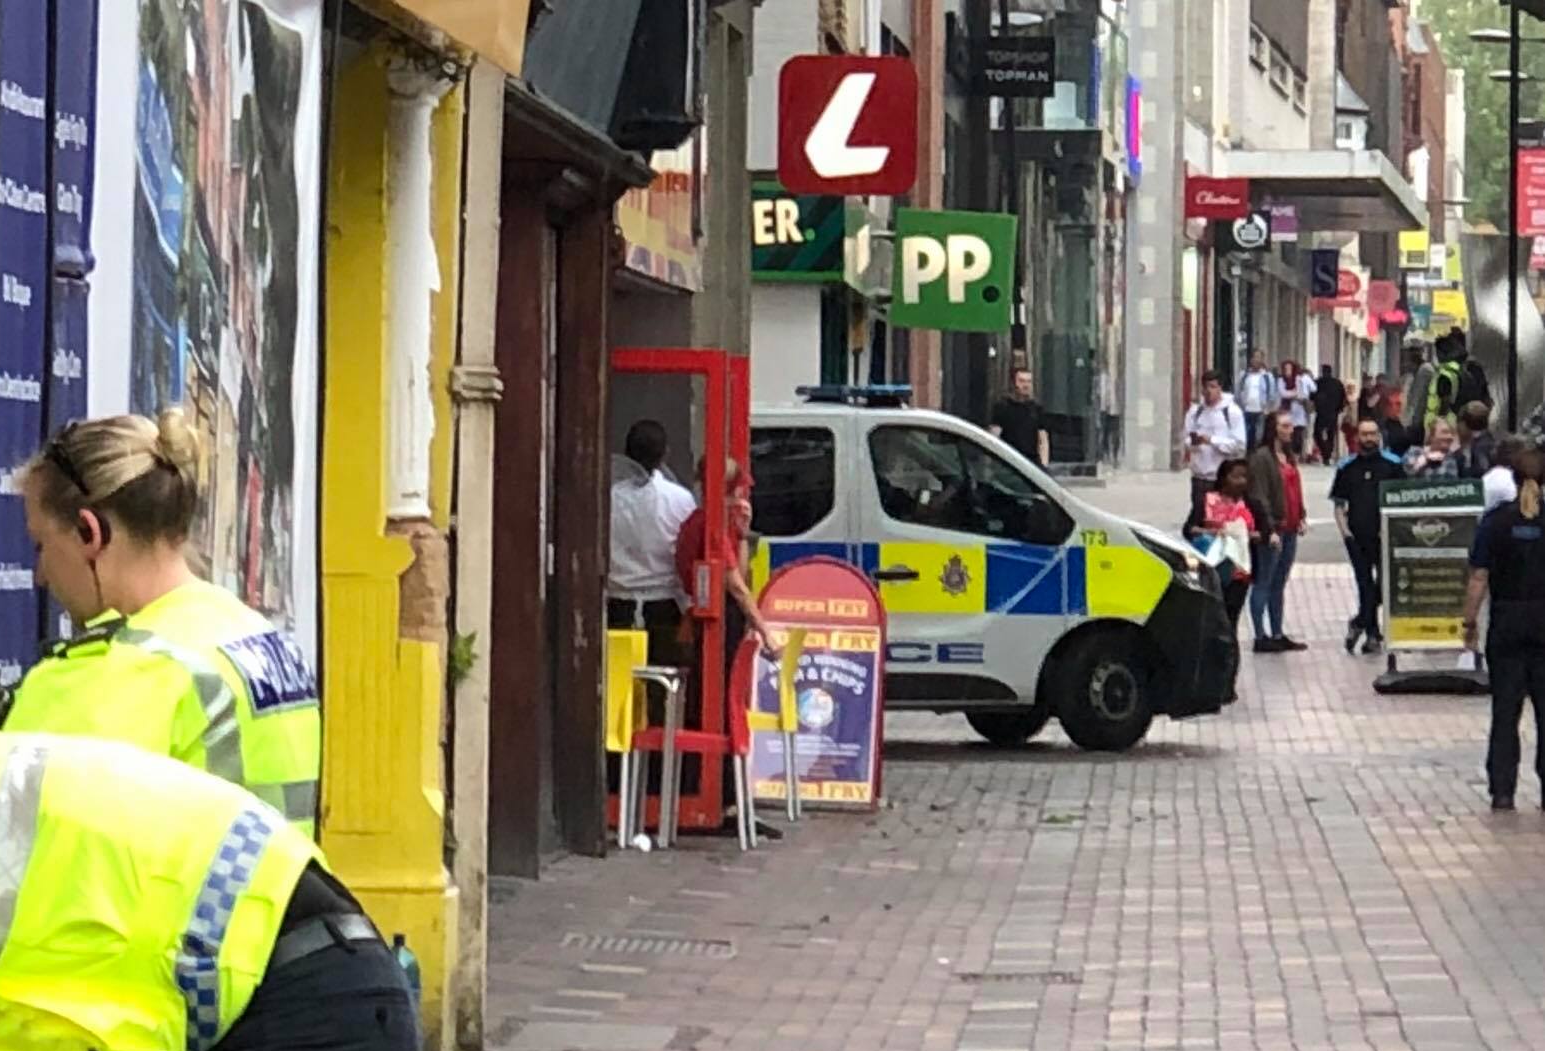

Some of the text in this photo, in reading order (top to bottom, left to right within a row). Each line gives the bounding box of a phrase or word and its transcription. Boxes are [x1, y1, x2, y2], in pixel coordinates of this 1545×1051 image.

[985, 69, 1049, 82] TOPMAN
[1079, 529, 1108, 547] 173
[833, 602, 865, 616] FRY
[837, 632, 876, 649] FRY
[821, 666, 867, 695] CHIPS
[828, 784, 867, 799] FRY
